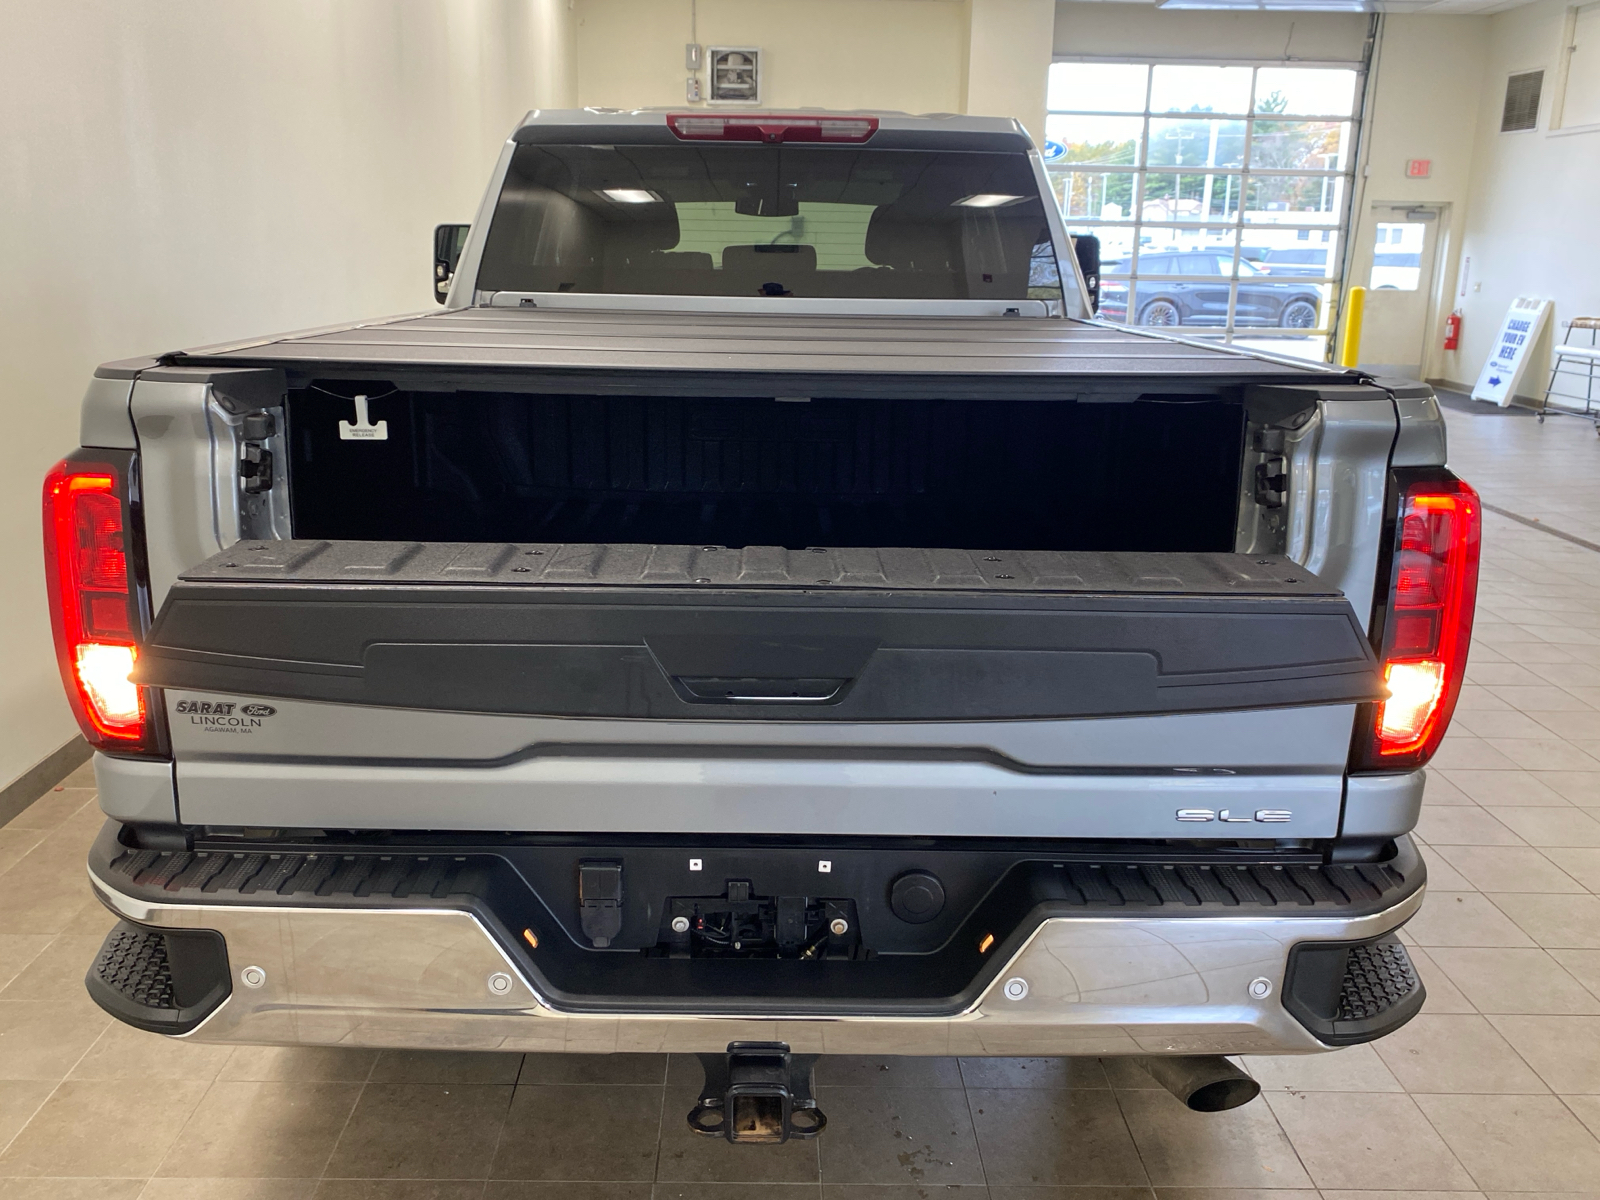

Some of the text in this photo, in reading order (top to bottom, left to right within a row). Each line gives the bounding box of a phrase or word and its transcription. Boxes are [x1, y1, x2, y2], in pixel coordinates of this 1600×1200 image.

[1507, 319, 1531, 333] CHARGE
[1502, 332, 1526, 346] YOUR EV
[1498, 345, 1517, 360] HERE
[176, 700, 270, 716] SARAT Ford
[191, 716, 262, 727] LINCOLN
[204, 726, 239, 734] AGAWAM,
[1175, 808, 1292, 822] SLE
